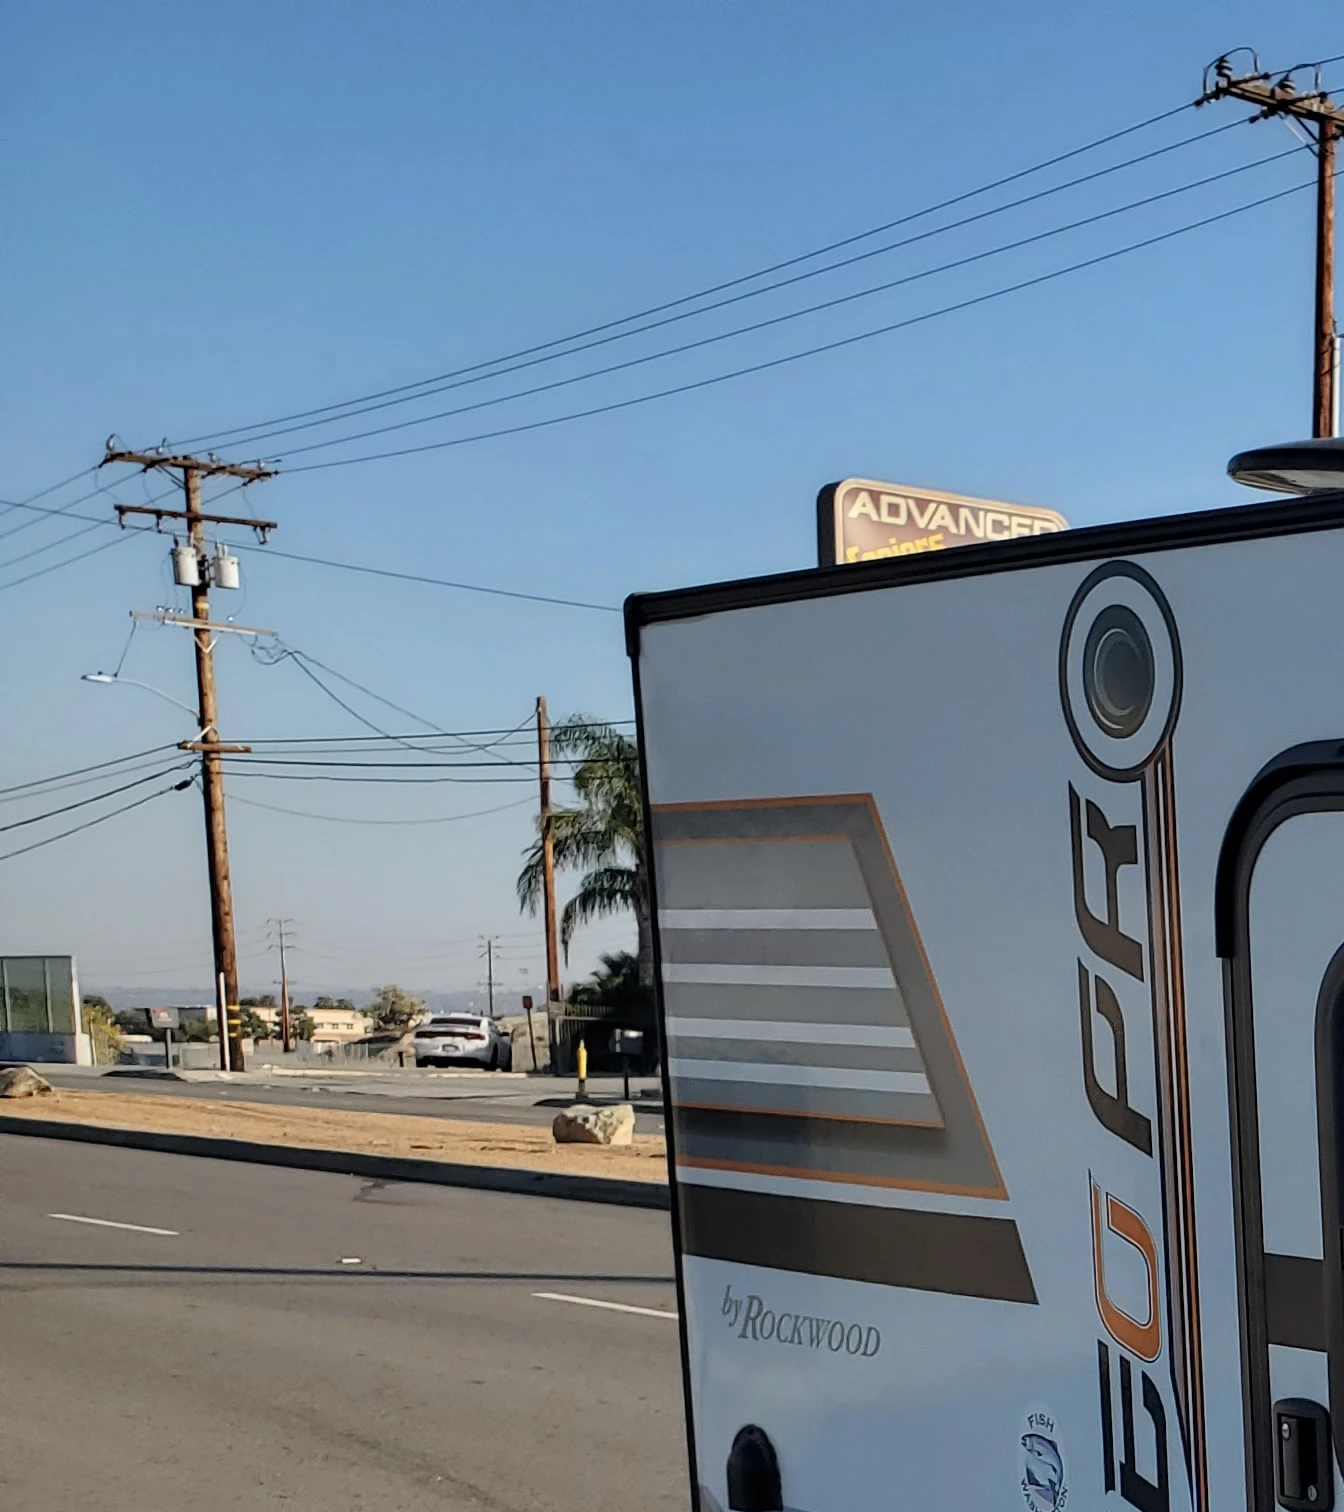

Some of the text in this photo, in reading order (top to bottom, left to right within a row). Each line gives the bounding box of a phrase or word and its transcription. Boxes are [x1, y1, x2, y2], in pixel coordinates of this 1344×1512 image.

[722, 1285, 881, 1357] by ROCKWOOD
[1027, 1413, 1056, 1434] FISH
